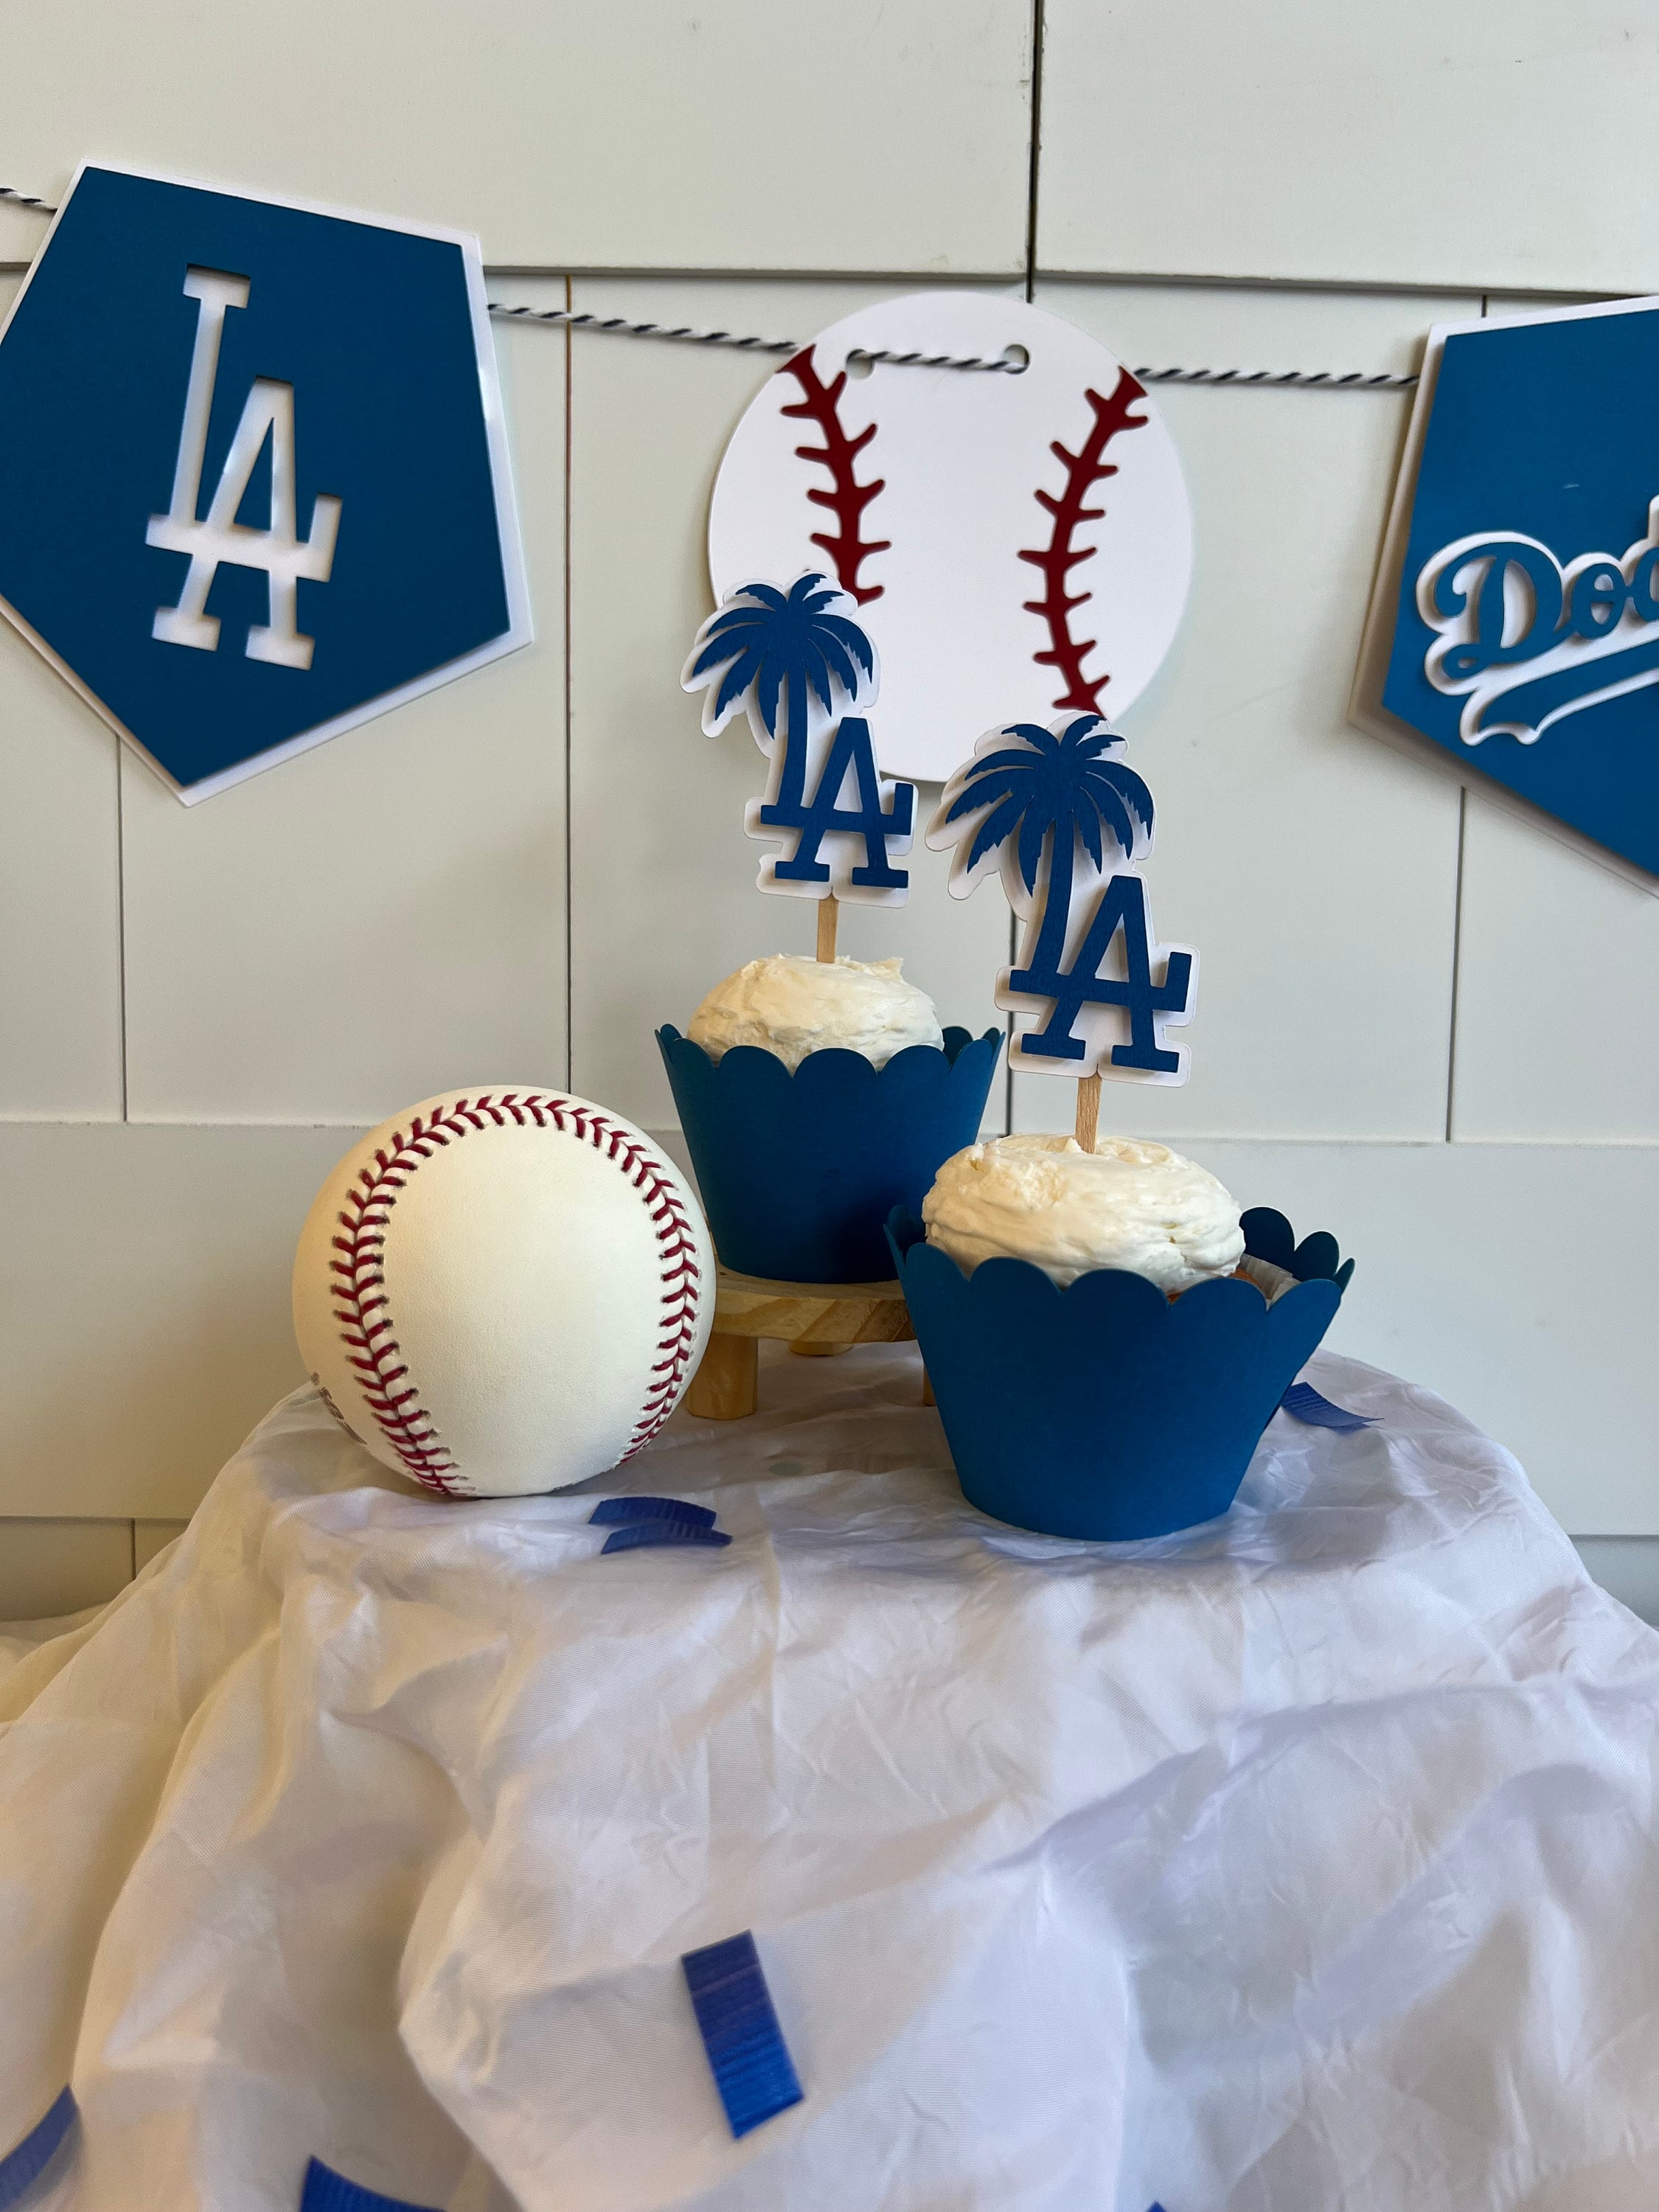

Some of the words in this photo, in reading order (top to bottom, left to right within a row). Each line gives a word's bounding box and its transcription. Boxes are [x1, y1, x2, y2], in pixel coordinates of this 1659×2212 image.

[145, 262, 343, 671] LA
[760, 655, 916, 889] LA
[1009, 807, 1192, 1074] LA
